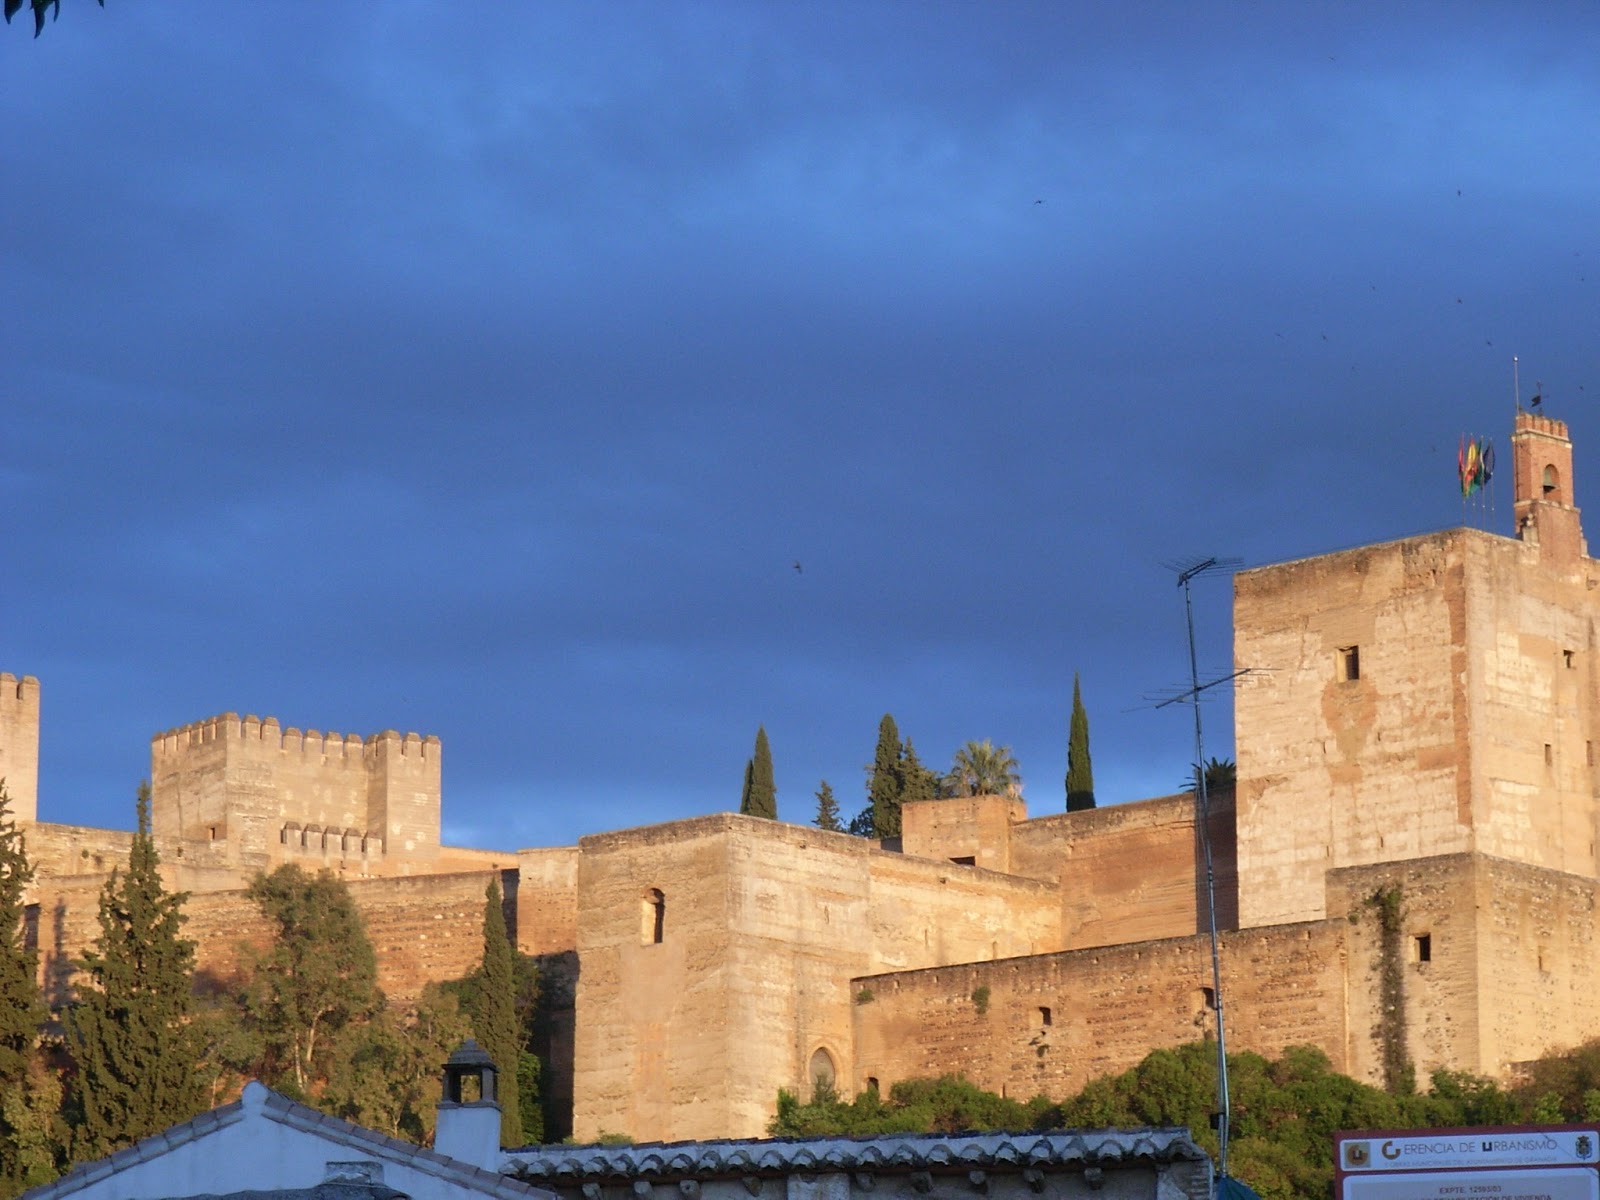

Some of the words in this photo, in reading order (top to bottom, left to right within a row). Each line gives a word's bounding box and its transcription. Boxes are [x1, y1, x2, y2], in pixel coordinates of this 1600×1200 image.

[1381, 1140, 1455, 1160] GERENCIA
[1459, 1142, 1476, 1153] DE
[1482, 1139, 1558, 1152] URBANISMO
